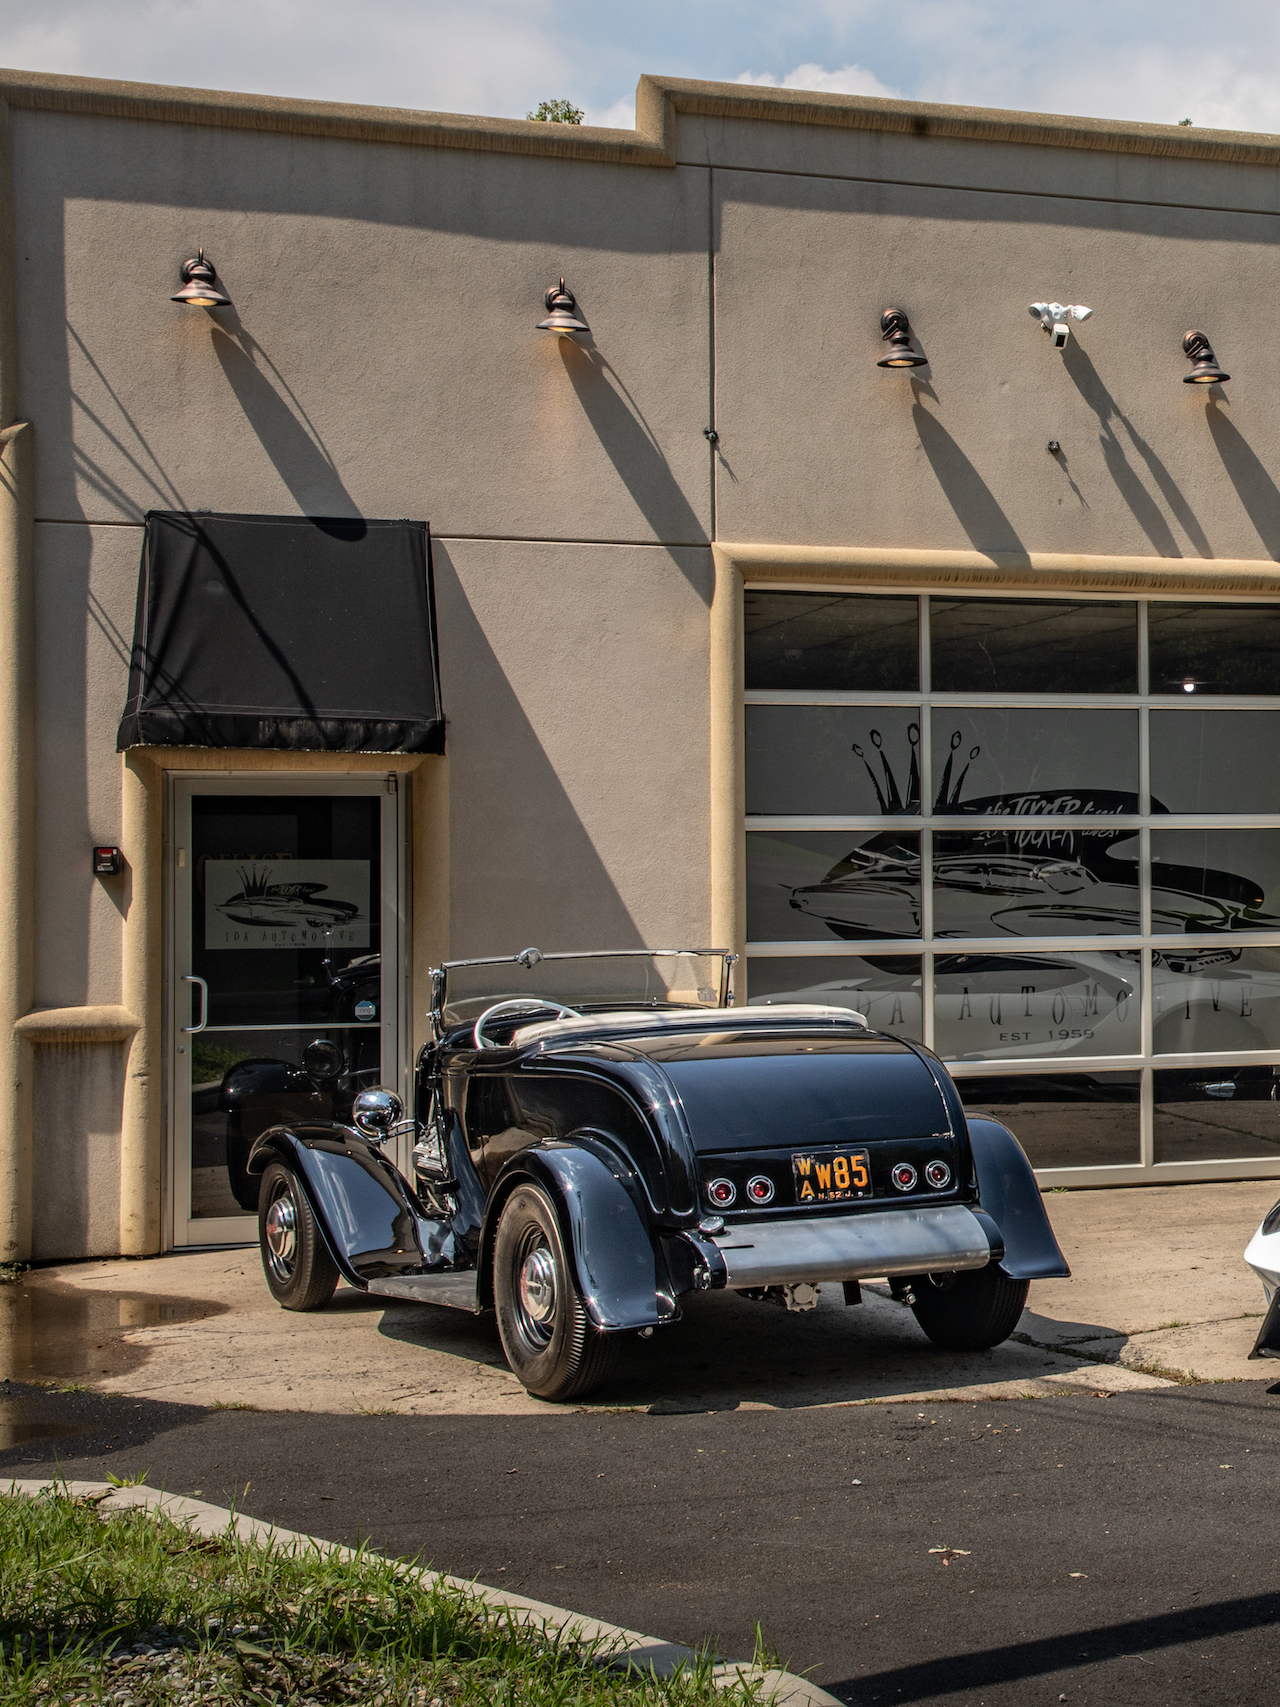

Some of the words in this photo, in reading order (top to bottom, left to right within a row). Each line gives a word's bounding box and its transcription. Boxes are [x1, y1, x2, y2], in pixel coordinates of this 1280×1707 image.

[225, 931, 250, 942] IDA
[262, 930, 355, 942] AUTOMOTVE
[1000, 1032, 1031, 1041] EST
[1048, 1029, 1095, 1040] 1959
[815, 1154, 868, 1189] W85
